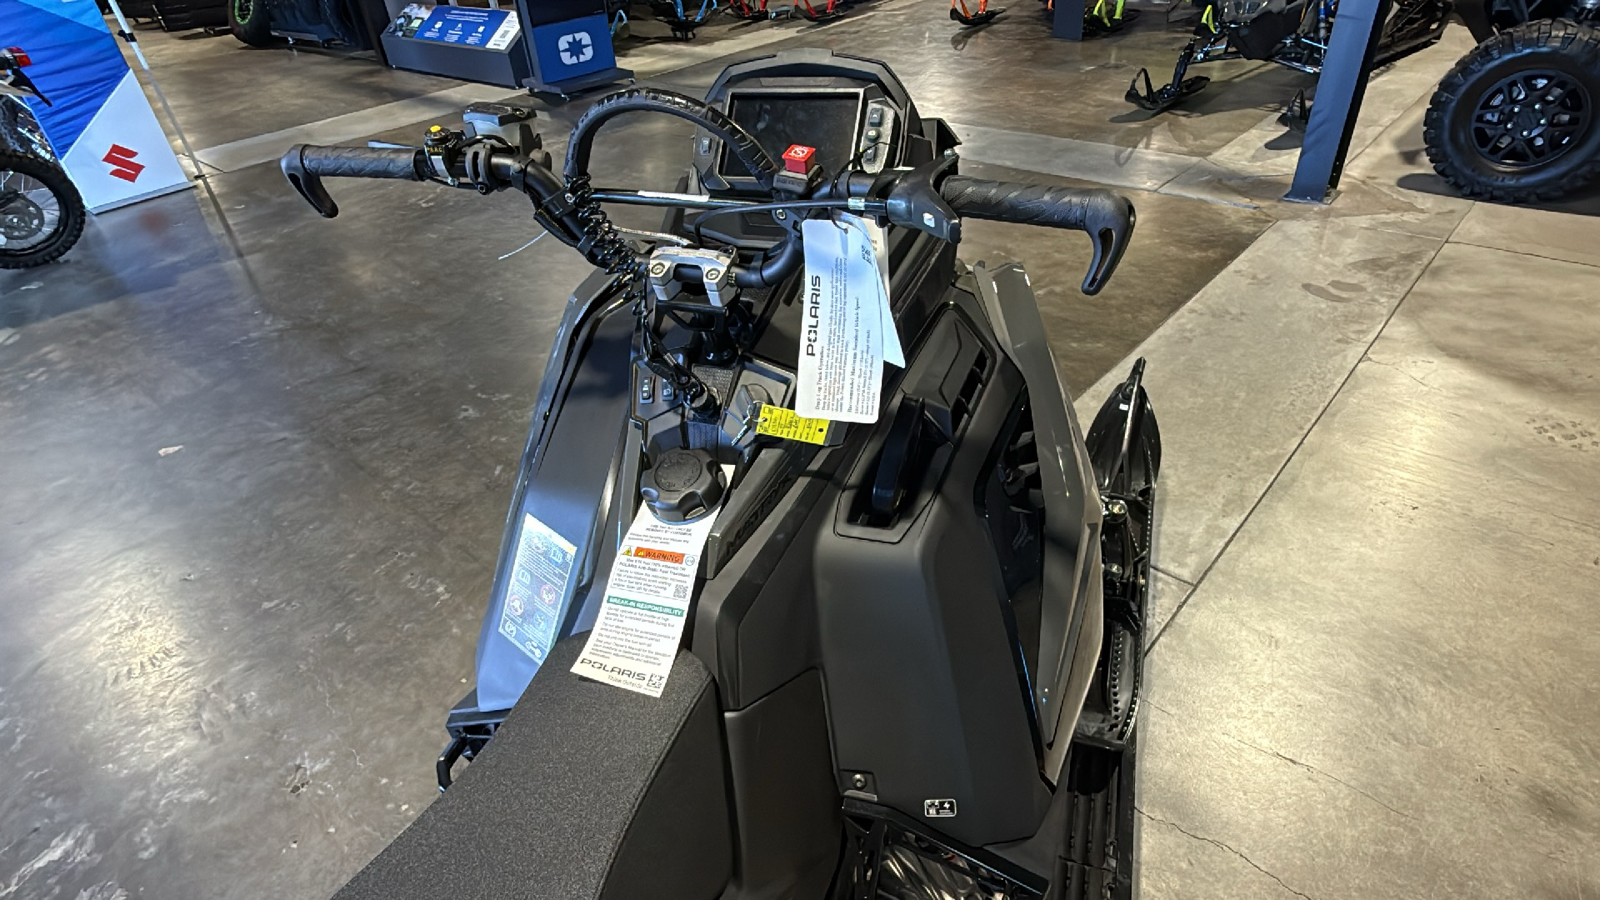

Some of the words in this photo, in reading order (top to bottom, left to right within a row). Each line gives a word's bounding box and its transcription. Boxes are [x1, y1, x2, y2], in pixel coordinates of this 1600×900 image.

[807, 275, 821, 356] POLARIS
[646, 551, 680, 562] WARNING
[610, 597, 636, 606] BREAK-IN
[637, 603, 682, 615] RESPONSIBILITY
[581, 658, 647, 681] POLARIS
